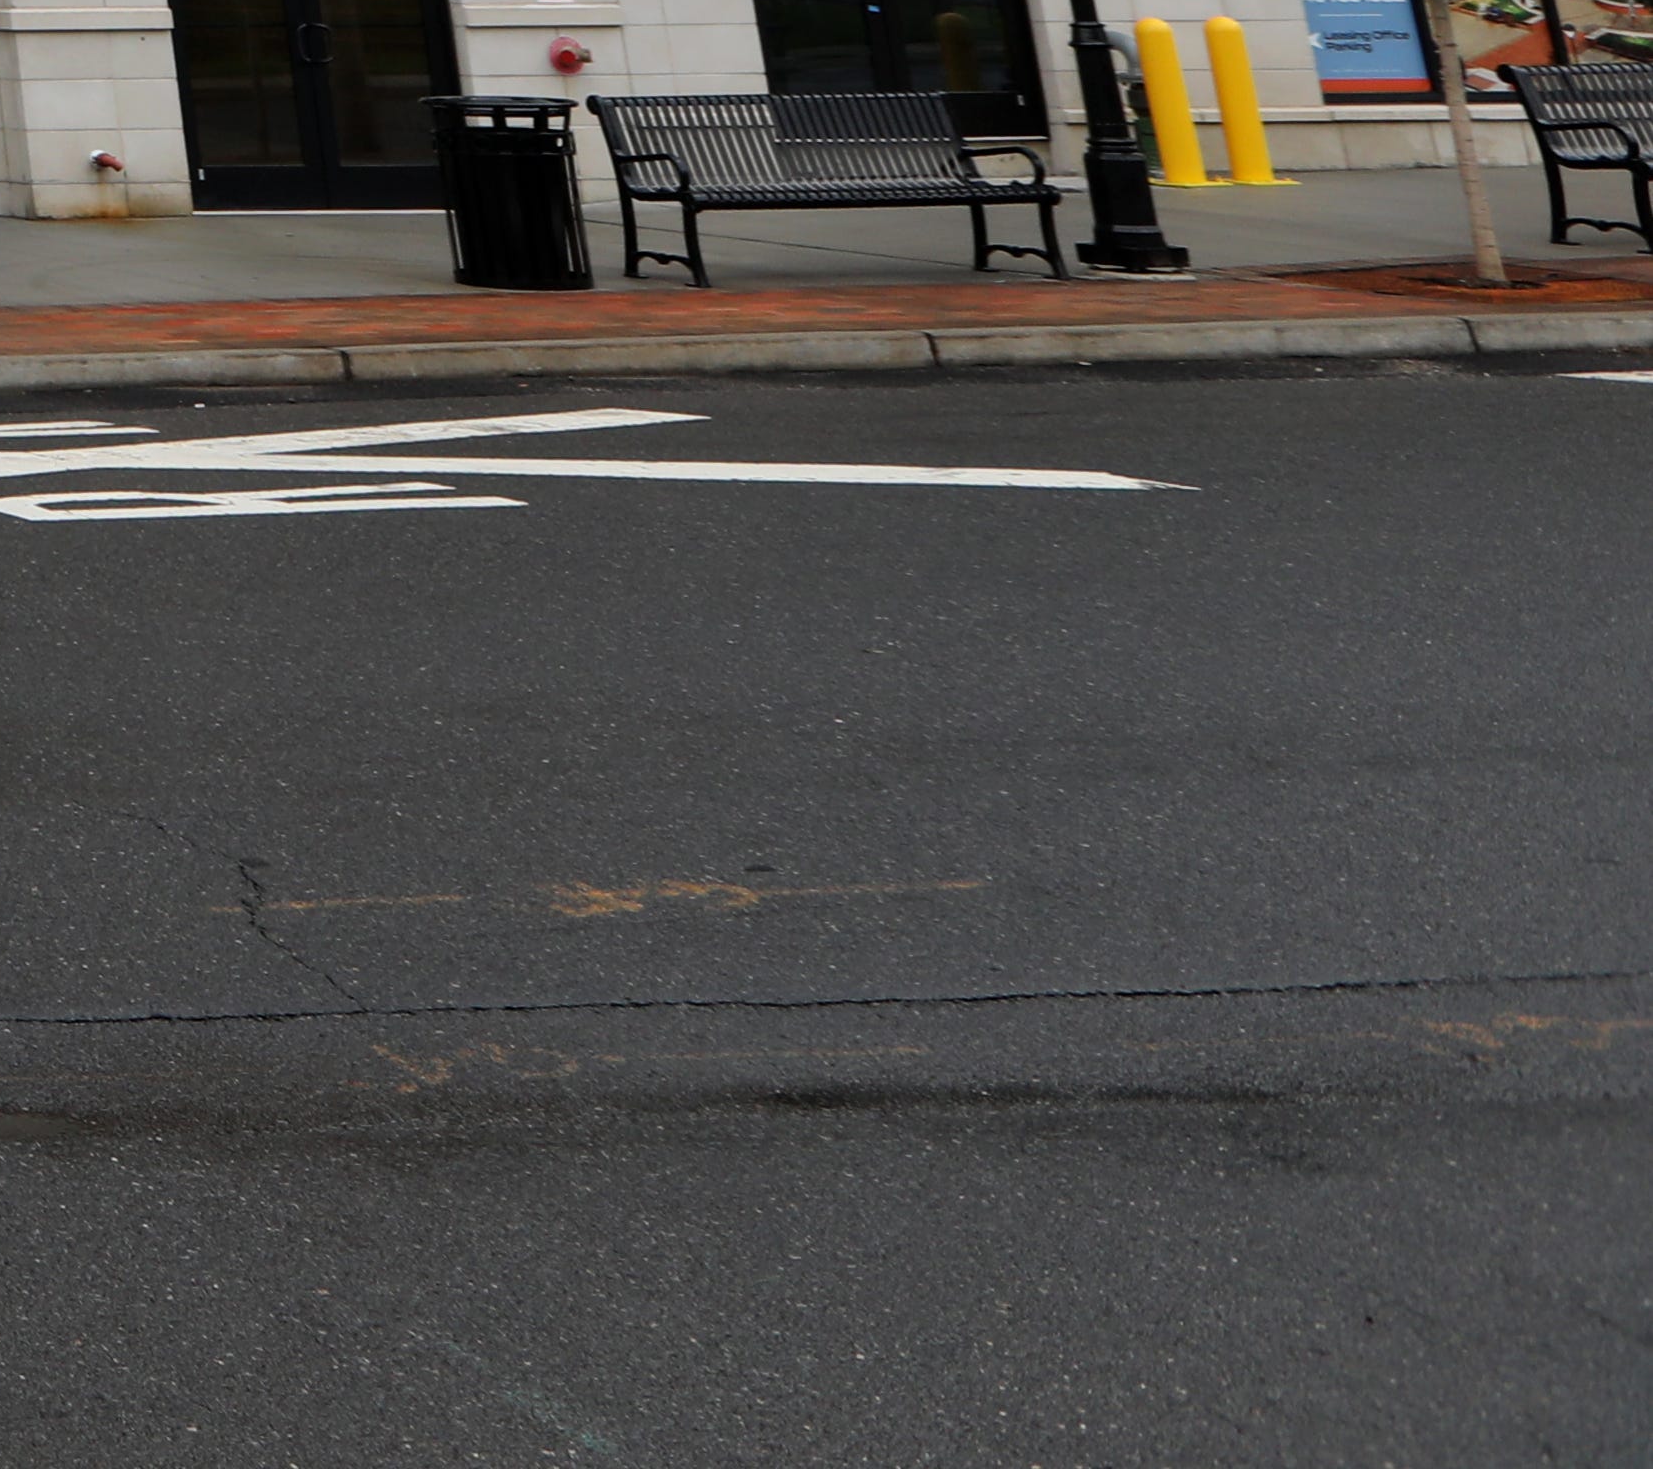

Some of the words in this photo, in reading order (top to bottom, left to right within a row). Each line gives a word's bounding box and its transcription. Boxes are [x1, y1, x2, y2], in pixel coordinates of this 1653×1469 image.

[1324, 31, 1370, 42] Leasing
[1372, 30, 1410, 41] Office
[1325, 42, 1373, 53] Parking
